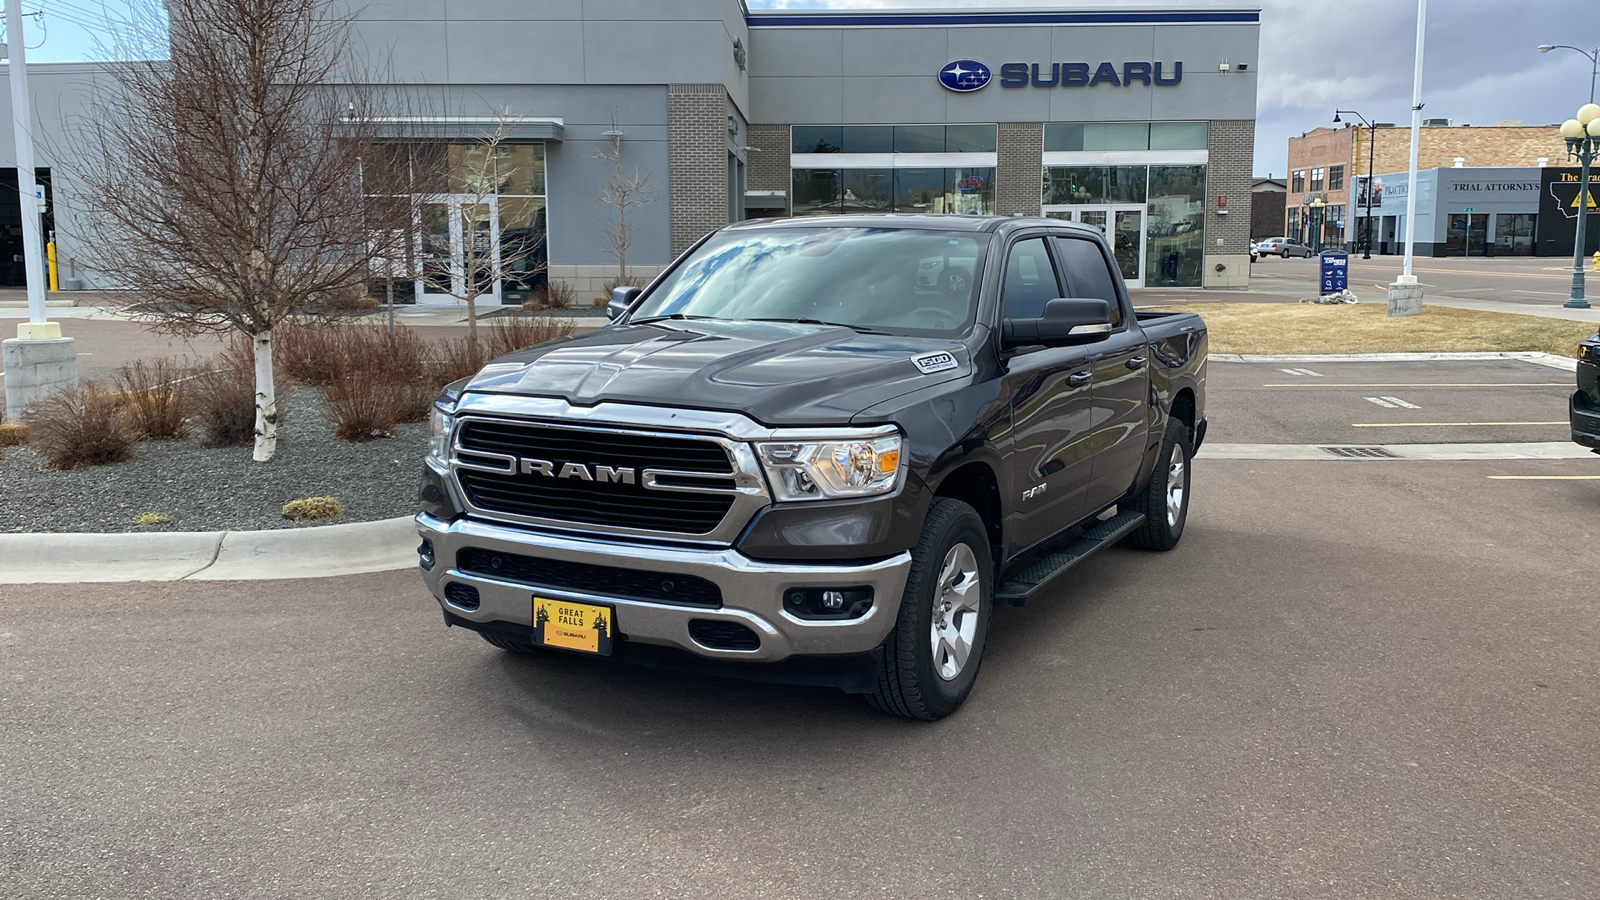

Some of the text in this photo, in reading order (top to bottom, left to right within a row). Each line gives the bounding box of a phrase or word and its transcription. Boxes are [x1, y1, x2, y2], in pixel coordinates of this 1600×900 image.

[1000, 61, 1183, 88] SUBARU
[1560, 173, 1579, 181] The
[1453, 182, 1540, 191] TRIAL ATTORNEYS
[918, 354, 950, 367] 1500
[520, 457, 635, 485] RAM
[1022, 482, 1047, 502] RAM
[558, 607, 584, 618] GREAT
[558, 615, 584, 627] FALLS
[563, 631, 587, 639] SUBARU
